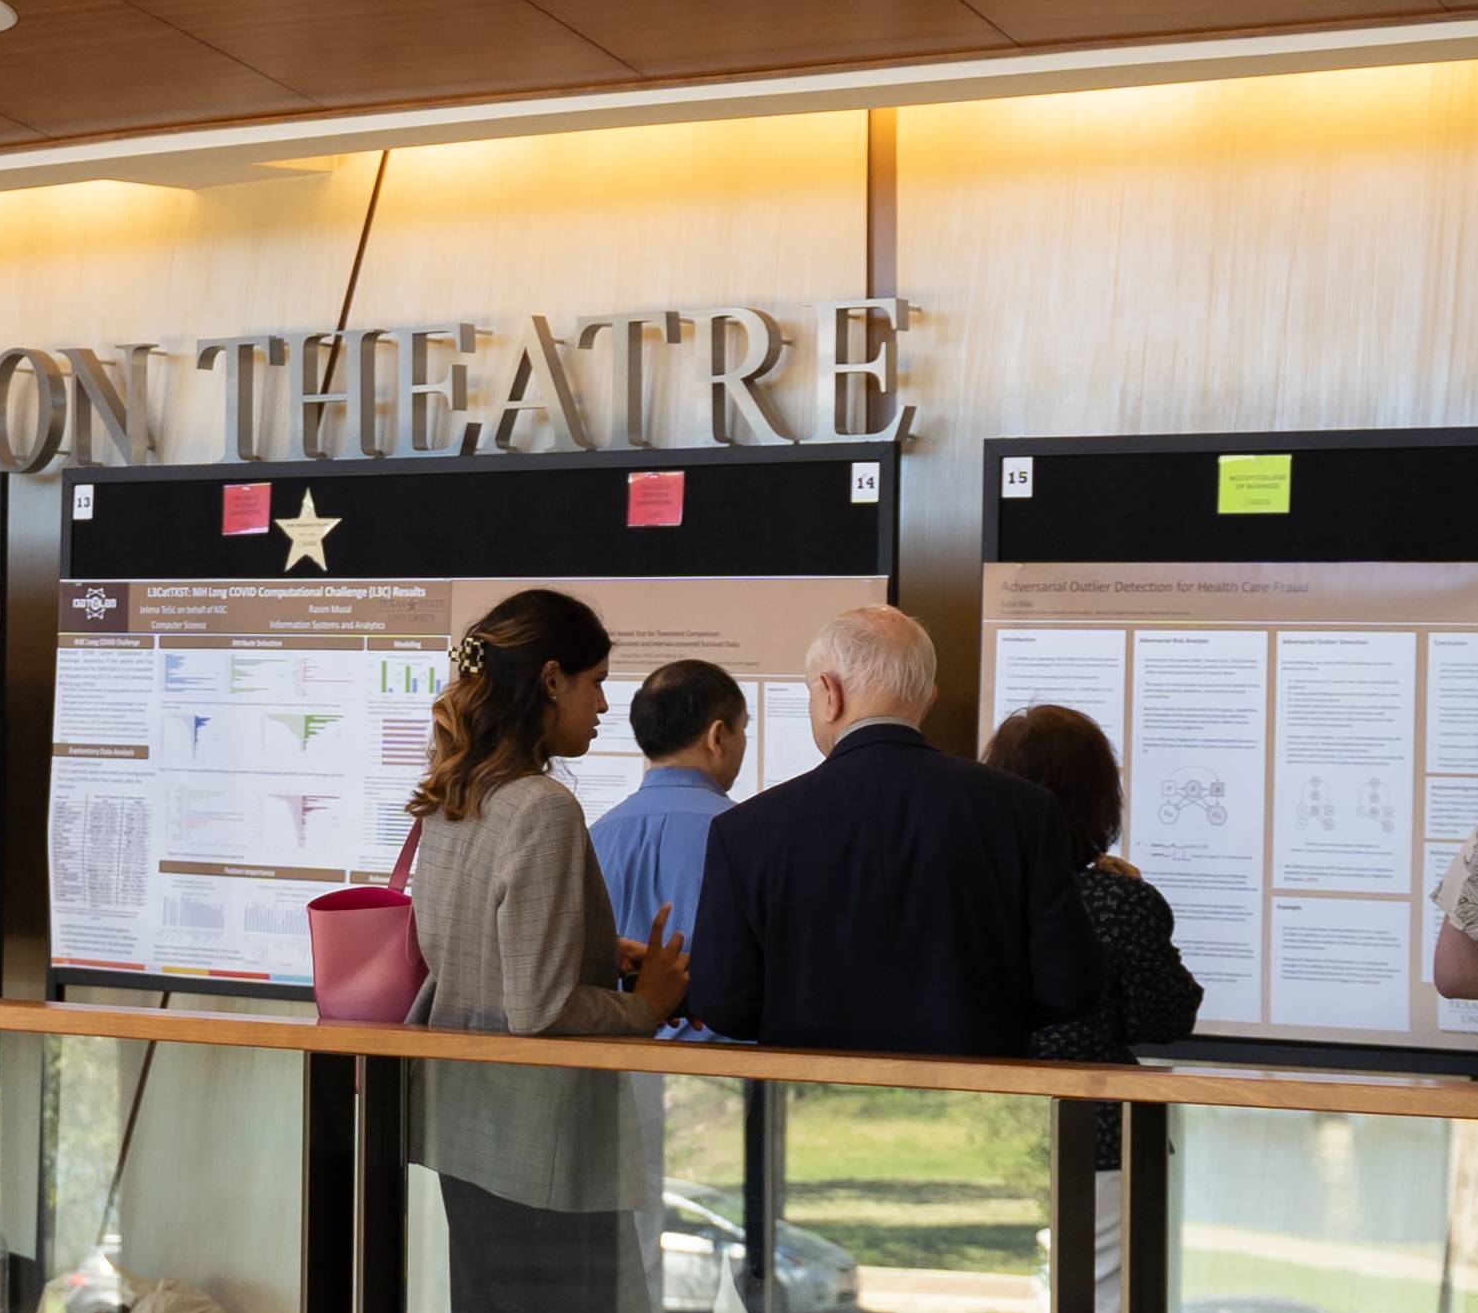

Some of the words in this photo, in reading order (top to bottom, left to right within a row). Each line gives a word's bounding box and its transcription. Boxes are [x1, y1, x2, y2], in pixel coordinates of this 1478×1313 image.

[195, 296, 918, 468] THEATRE
[857, 476, 875, 489] 14
[1008, 471, 1028, 485] 15
[77, 497, 91, 509] 13
[193, 586, 207, 597] NIH
[209, 587, 227, 599] Long
[228, 587, 256, 598] COVID
[258, 587, 323, 599] Computational
[324, 587, 368, 599] Challenge
[368, 586, 392, 598] (L3C)
[394, 587, 426, 598] Results
[1001, 581, 1067, 593] Adversarial
[1069, 581, 1111, 593] Outlier
[1113, 581, 1174, 593] Detection
[1176, 581, 1196, 593] for
[1197, 581, 1239, 593] Health
[1240, 582, 1268, 593] Care
[1271, 582, 1309, 593] Fraud
[151, 621, 184, 631] Computer
[185, 621, 207, 631] Science
[269, 621, 311, 630] Information
[312, 621, 339, 631] Systems
[341, 621, 353, 630] and
[355, 621, 386, 631] Analytics
[1139, 637, 1172, 645] Adversarial
[1186, 638, 1210, 646] Analysis
